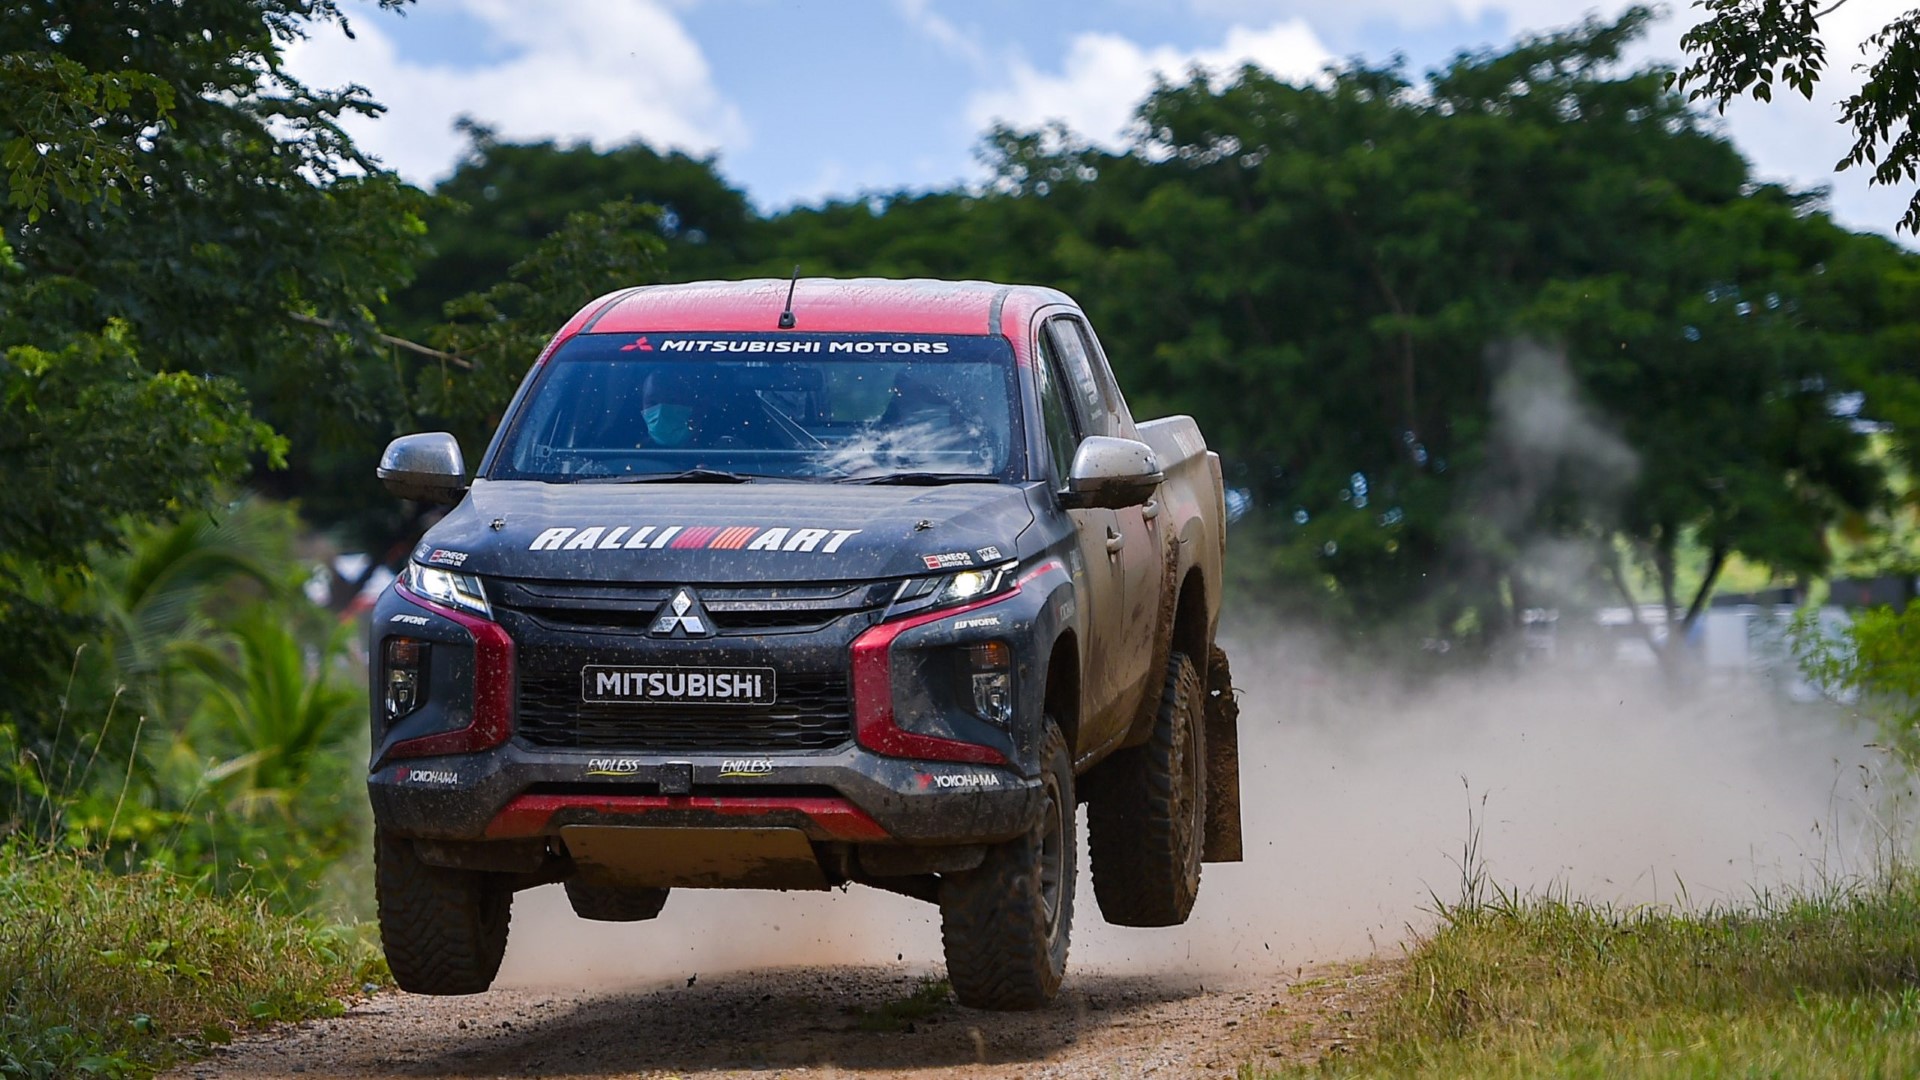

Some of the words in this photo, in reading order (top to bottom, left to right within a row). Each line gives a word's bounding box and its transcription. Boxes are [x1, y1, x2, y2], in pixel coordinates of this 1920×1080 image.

[660, 340, 820, 353] MITSUBISHI
[828, 342, 949, 354] MOTORS
[528, 526, 683, 550] RALLI
[747, 527, 863, 553] ART
[442, 550, 469, 562] ENEOS
[938, 552, 971, 562] ENEOS
[941, 560, 963, 568] MOTOR
[968, 617, 1000, 628] WORK
[597, 672, 761, 697] MITSUBISHI
[588, 759, 640, 772] ENDLESS
[721, 760, 774, 773] ENDLESS
[933, 774, 1000, 787] YOKOHAMA
